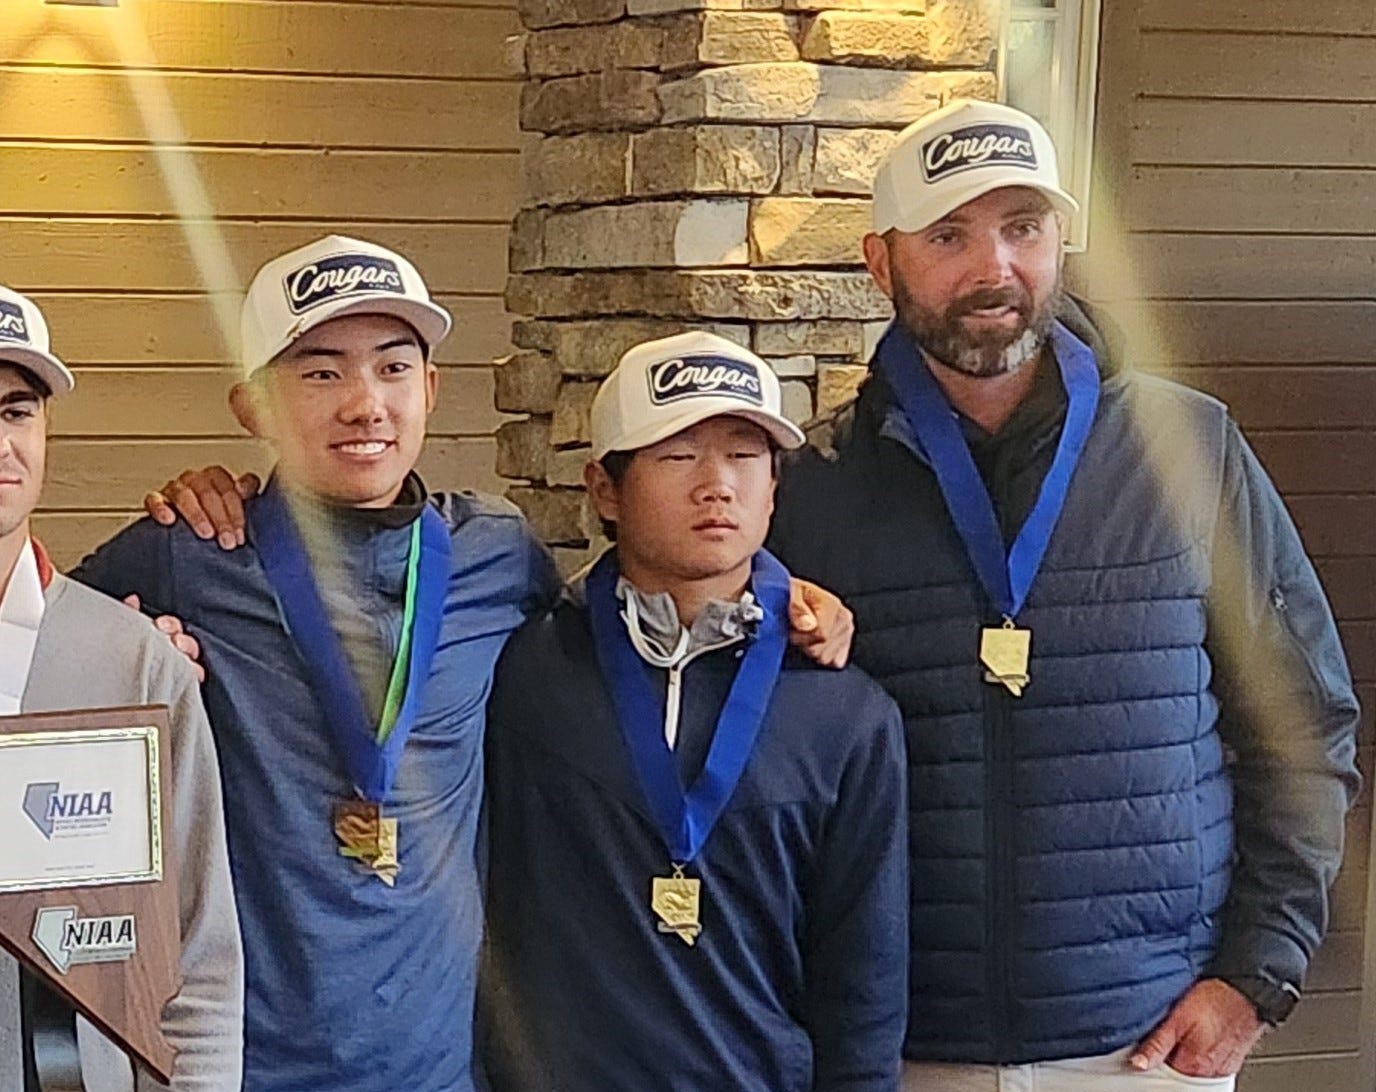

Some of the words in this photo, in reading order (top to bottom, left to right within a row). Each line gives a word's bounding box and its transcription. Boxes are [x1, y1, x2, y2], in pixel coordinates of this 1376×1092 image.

[926, 134, 1032, 169] Cougars
[291, 264, 400, 301] Cougars
[654, 359, 760, 392] Cougars
[50, 791, 113, 817] NIAA
[65, 918, 133, 947] NIAA
